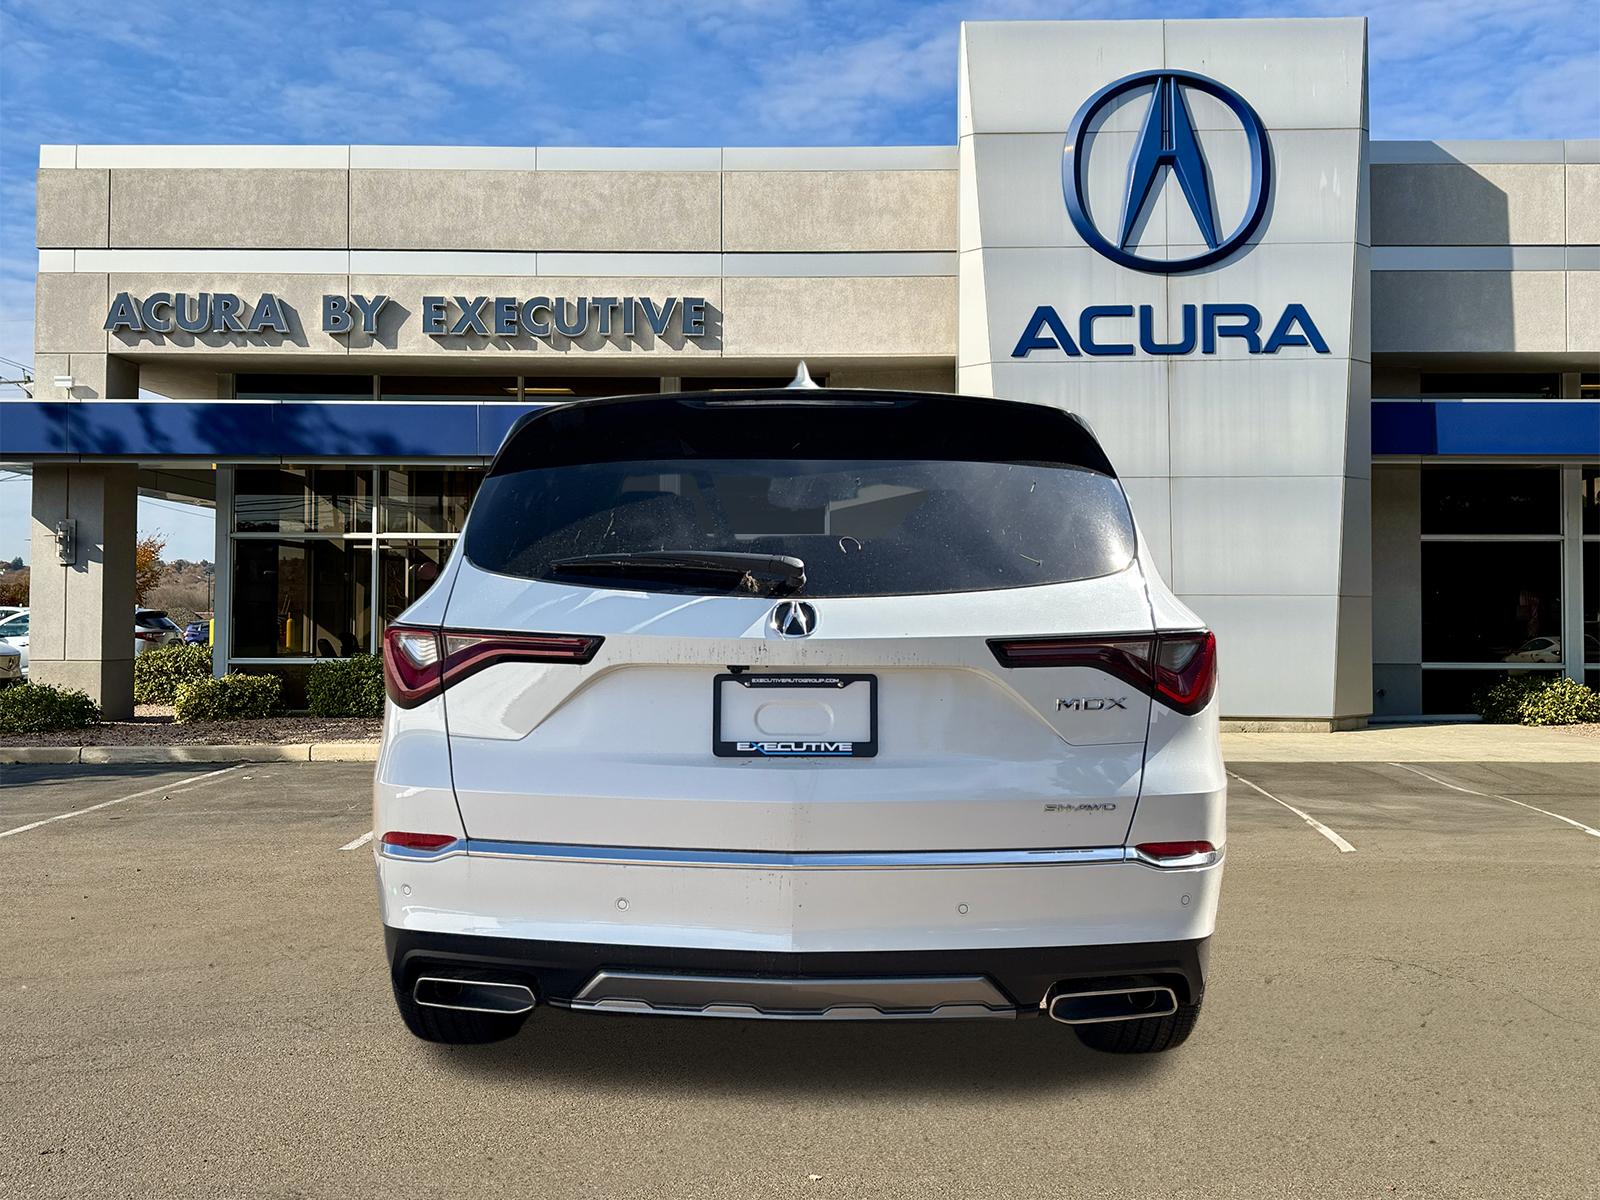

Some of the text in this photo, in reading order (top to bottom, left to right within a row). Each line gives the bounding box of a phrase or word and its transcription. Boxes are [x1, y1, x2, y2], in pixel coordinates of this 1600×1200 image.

[104, 292, 707, 336] ACURA BY EXECUTIVE
[1011, 303, 1332, 358] ACURA
[1056, 697, 1128, 711] MDX
[736, 742, 853, 752] EXECUTIVE
